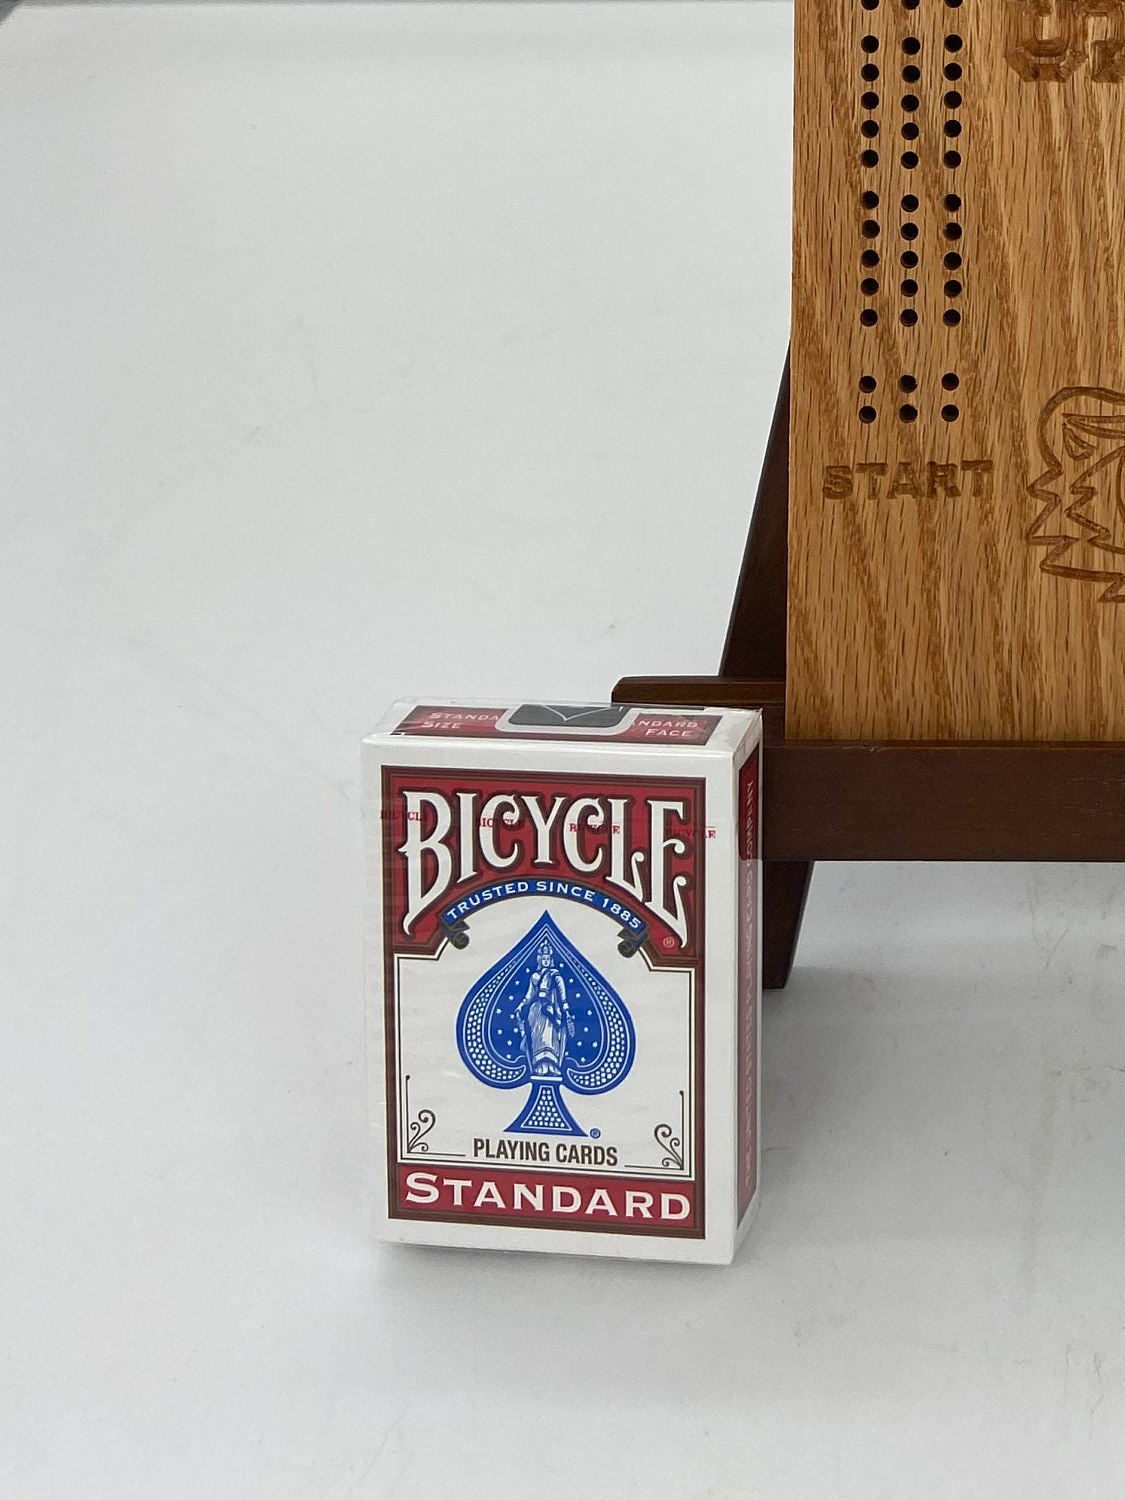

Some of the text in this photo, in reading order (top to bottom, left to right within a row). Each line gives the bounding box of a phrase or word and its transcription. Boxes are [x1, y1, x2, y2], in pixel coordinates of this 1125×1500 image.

[821, 459, 994, 501] START
[421, 720, 464, 729] SIZE
[429, 712, 499, 721] STANDA
[633, 720, 698, 728] NDARD
[645, 728, 694, 737] FACE
[745, 778, 755, 867] COMPANY
[398, 790, 689, 950] BICYCLE
[446, 880, 642, 930] TRUSTED SINCE 1885
[745, 870, 755, 922] CARD
[473, 1138, 618, 1167] PLAYING CARDS
[405, 1172, 691, 1220] STANDARD
